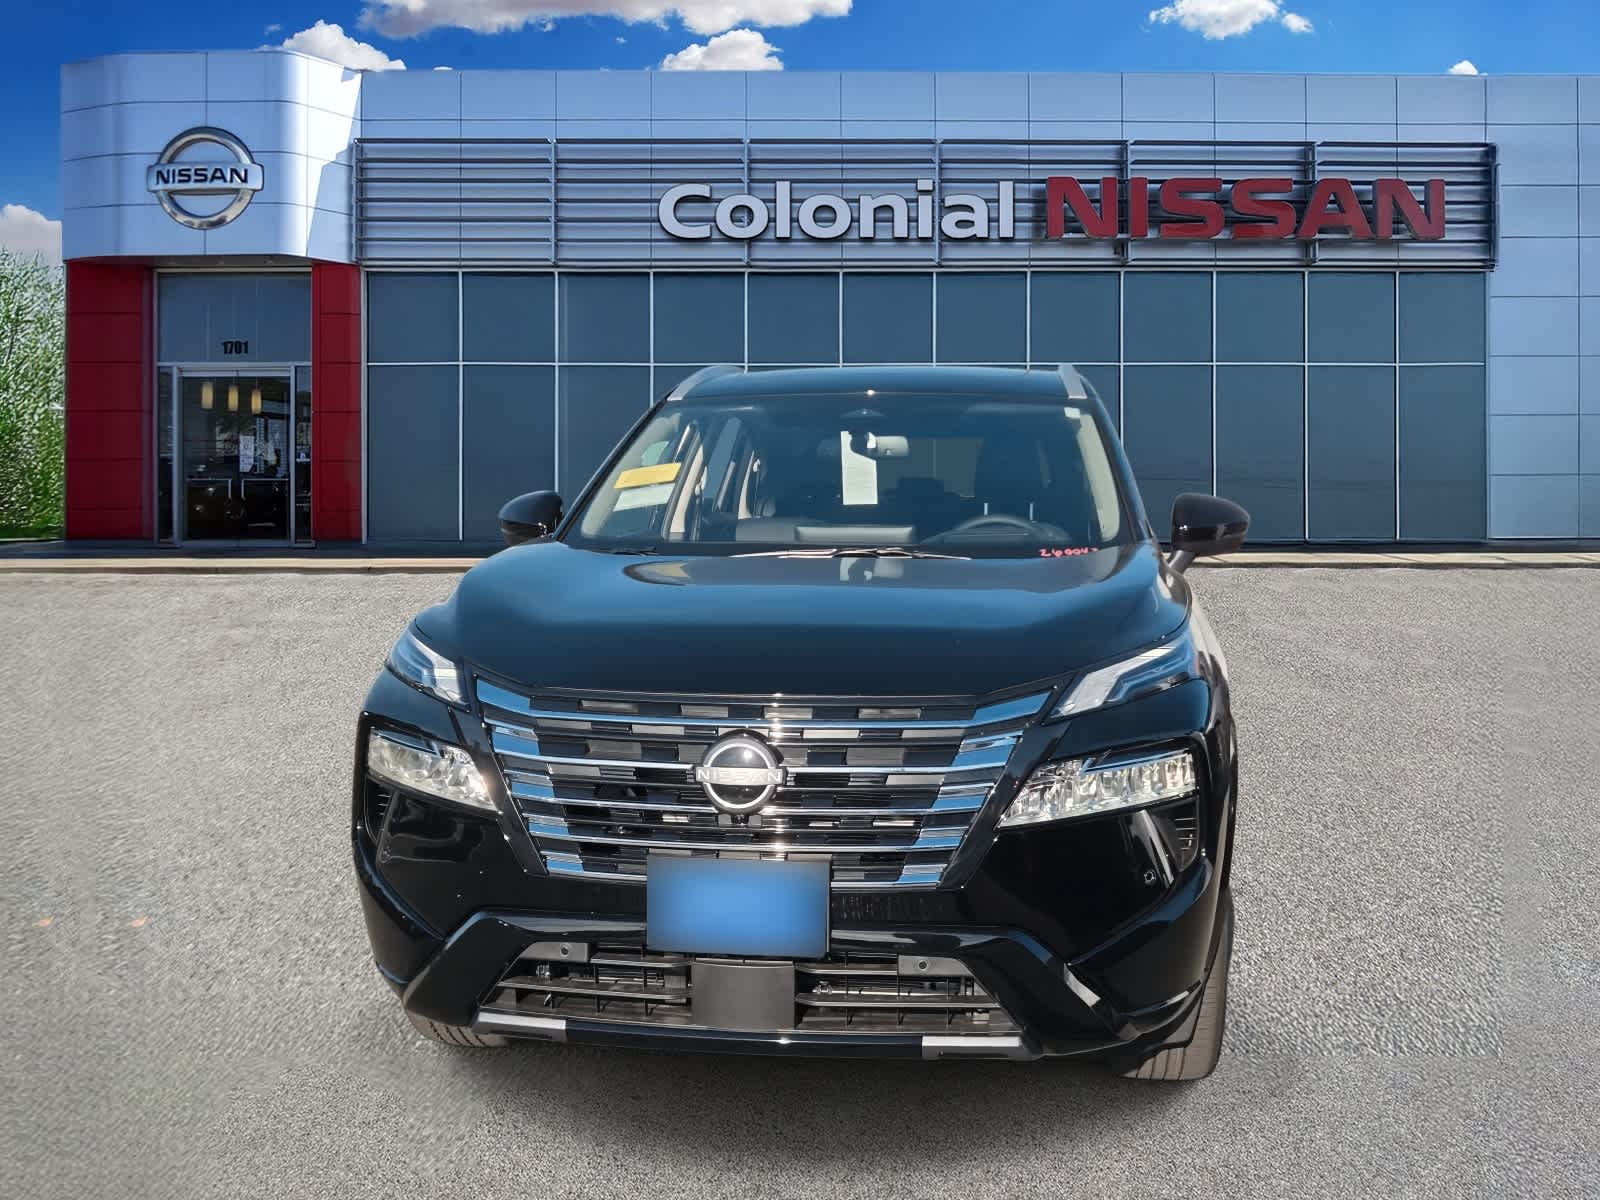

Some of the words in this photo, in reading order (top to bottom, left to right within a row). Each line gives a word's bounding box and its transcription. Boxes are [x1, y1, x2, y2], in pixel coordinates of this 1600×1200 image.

[156, 167, 248, 185] NISSAN
[658, 179, 1014, 240] Colonial
[1046, 176, 1446, 240] NISSAN
[222, 340, 249, 354] 1701
